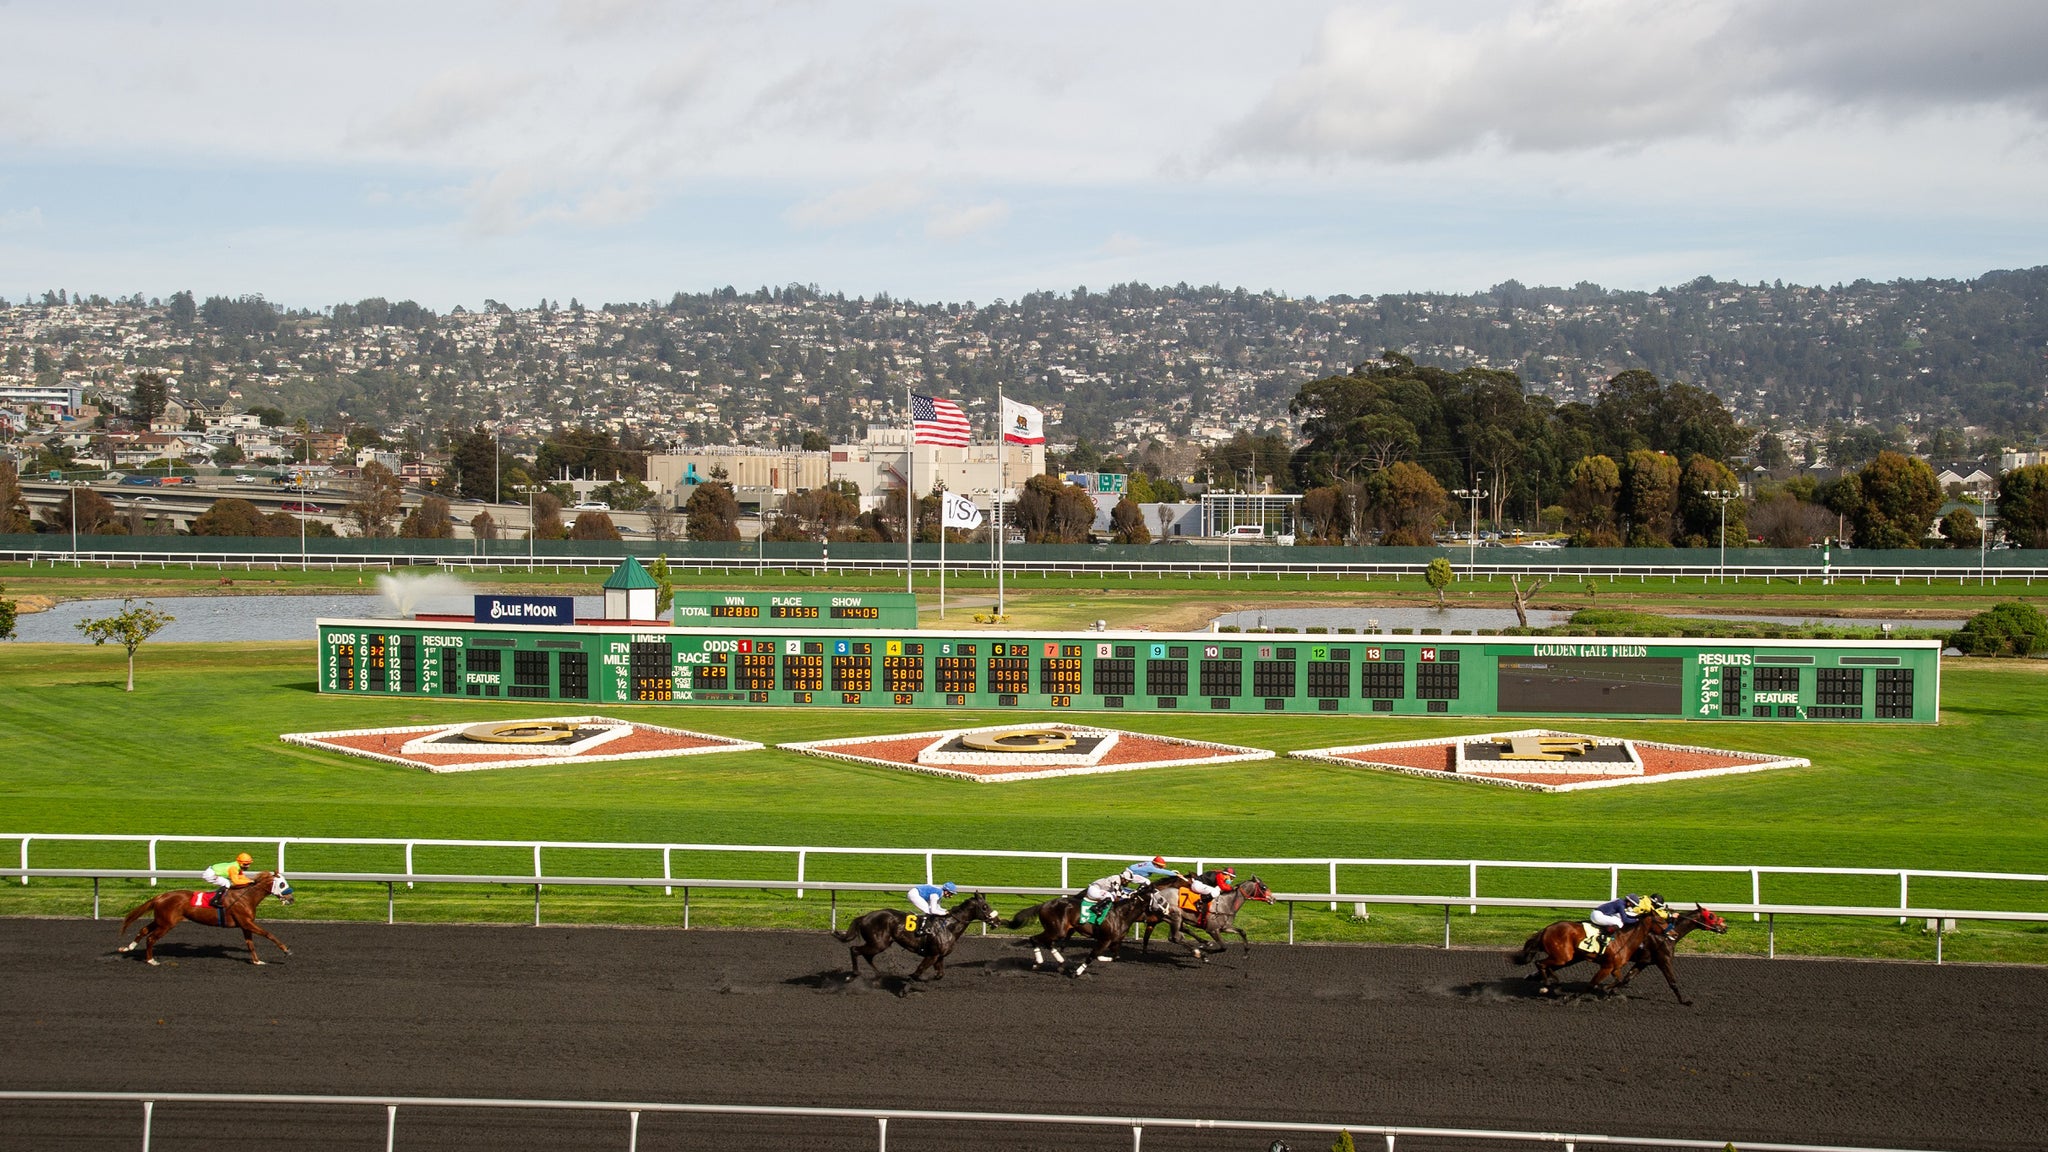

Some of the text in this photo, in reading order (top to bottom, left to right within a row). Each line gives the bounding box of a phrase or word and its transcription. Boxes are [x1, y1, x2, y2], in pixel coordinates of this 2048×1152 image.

[725, 597, 745, 605] WIN
[772, 597, 802, 606] PLACE
[832, 598, 861, 606] SHOW
[491, 601, 557, 618] BLUE MOON
[681, 607, 710, 616] TOTAL
[714, 607, 758, 617] 112880
[780, 608, 818, 618] 31536
[842, 608, 878, 618] 14409
[327, 633, 355, 644] ODDS
[360, 634, 368, 645] 5
[378, 635, 384, 644] 4
[388, 635, 400, 646] 10
[422, 635, 463, 647] RESULTS
[330, 645, 336, 655] 1
[339, 645, 354, 655] 25
[360, 646, 368, 656] 6
[610, 642, 630, 653] FIN
[703, 640, 738, 652] ODDS
[742, 642, 748, 651] 1
[757, 643, 774, 653] 25
[790, 643, 797, 652] 2
[816, 643, 823, 653] 7
[838, 643, 846, 652] 3
[864, 644, 871, 654] 5
[891, 644, 897, 652] 4
[917, 644, 923, 654] 3
[942, 644, 950, 654] 5
[968, 645, 975, 655] 4
[994, 645, 1003, 655] 6
[1048, 646, 1055, 655] 7
[1067, 646, 1081, 656] 16
[1101, 646, 1108, 655] 8
[1154, 646, 1161, 656] 9
[1533, 644, 1647, 657] GOLDEN GATE FIELDS
[388, 646, 398, 657] 11
[1205, 647, 1218, 657] 10
[1261, 648, 1270, 657] 11
[1313, 648, 1325, 658] 12
[1367, 649, 1380, 659] 13
[1422, 650, 1435, 660] 14
[329, 656, 337, 667] 2
[348, 657, 354, 666] 7
[360, 657, 368, 668] 7
[604, 654, 630, 665] MILE
[677, 652, 710, 663] RACE
[720, 653, 727, 662] 4
[744, 655, 774, 665] 3380
[787, 656, 823, 666] 11706
[836, 656, 871, 666] 14717
[884, 657, 923, 667] 22737
[1698, 653, 1751, 666] RESULTS
[373, 658, 384, 668] 16
[389, 658, 400, 669] 12
[940, 658, 975, 668] 17917
[989, 659, 1028, 669] 37111
[1049, 659, 1081, 669] 5309
[329, 667, 337, 678] 3
[348, 668, 354, 678] 5
[360, 669, 368, 680] 8
[388, 669, 401, 680] 13
[746, 667, 774, 677] 1461
[792, 668, 823, 678] 4333
[840, 669, 871, 679] 3829
[892, 669, 923, 679] 5800
[944, 670, 975, 680] 4714
[997, 670, 1028, 680] 9587
[1053, 671, 1081, 681] 1808
[1702, 666, 1719, 678] 1ST
[466, 673, 500, 684] FEATURE
[329, 679, 337, 690] 4
[348, 680, 354, 690] 3
[360, 680, 368, 690] 9
[388, 681, 401, 692] 14
[751, 680, 774, 689] 812
[795, 680, 823, 690] 1618
[843, 681, 871, 691] 1853
[892, 681, 923, 691] 2241
[944, 682, 975, 692] 2318
[997, 683, 1028, 693] 4185
[1053, 683, 1081, 693] 1379
[672, 691, 693, 700] TRACK
[754, 692, 767, 702] 15
[805, 693, 812, 703] 6
[957, 695, 964, 705] 8
[1754, 693, 1798, 703] FEATURE
[1052, 696, 1070, 707] 20
[195, 892, 204, 906] 1
[1180, 893, 1190, 907] 7
[1080, 904, 1091, 924] 5
[905, 914, 918, 932] 6
[1583, 935, 1594, 949] 4
